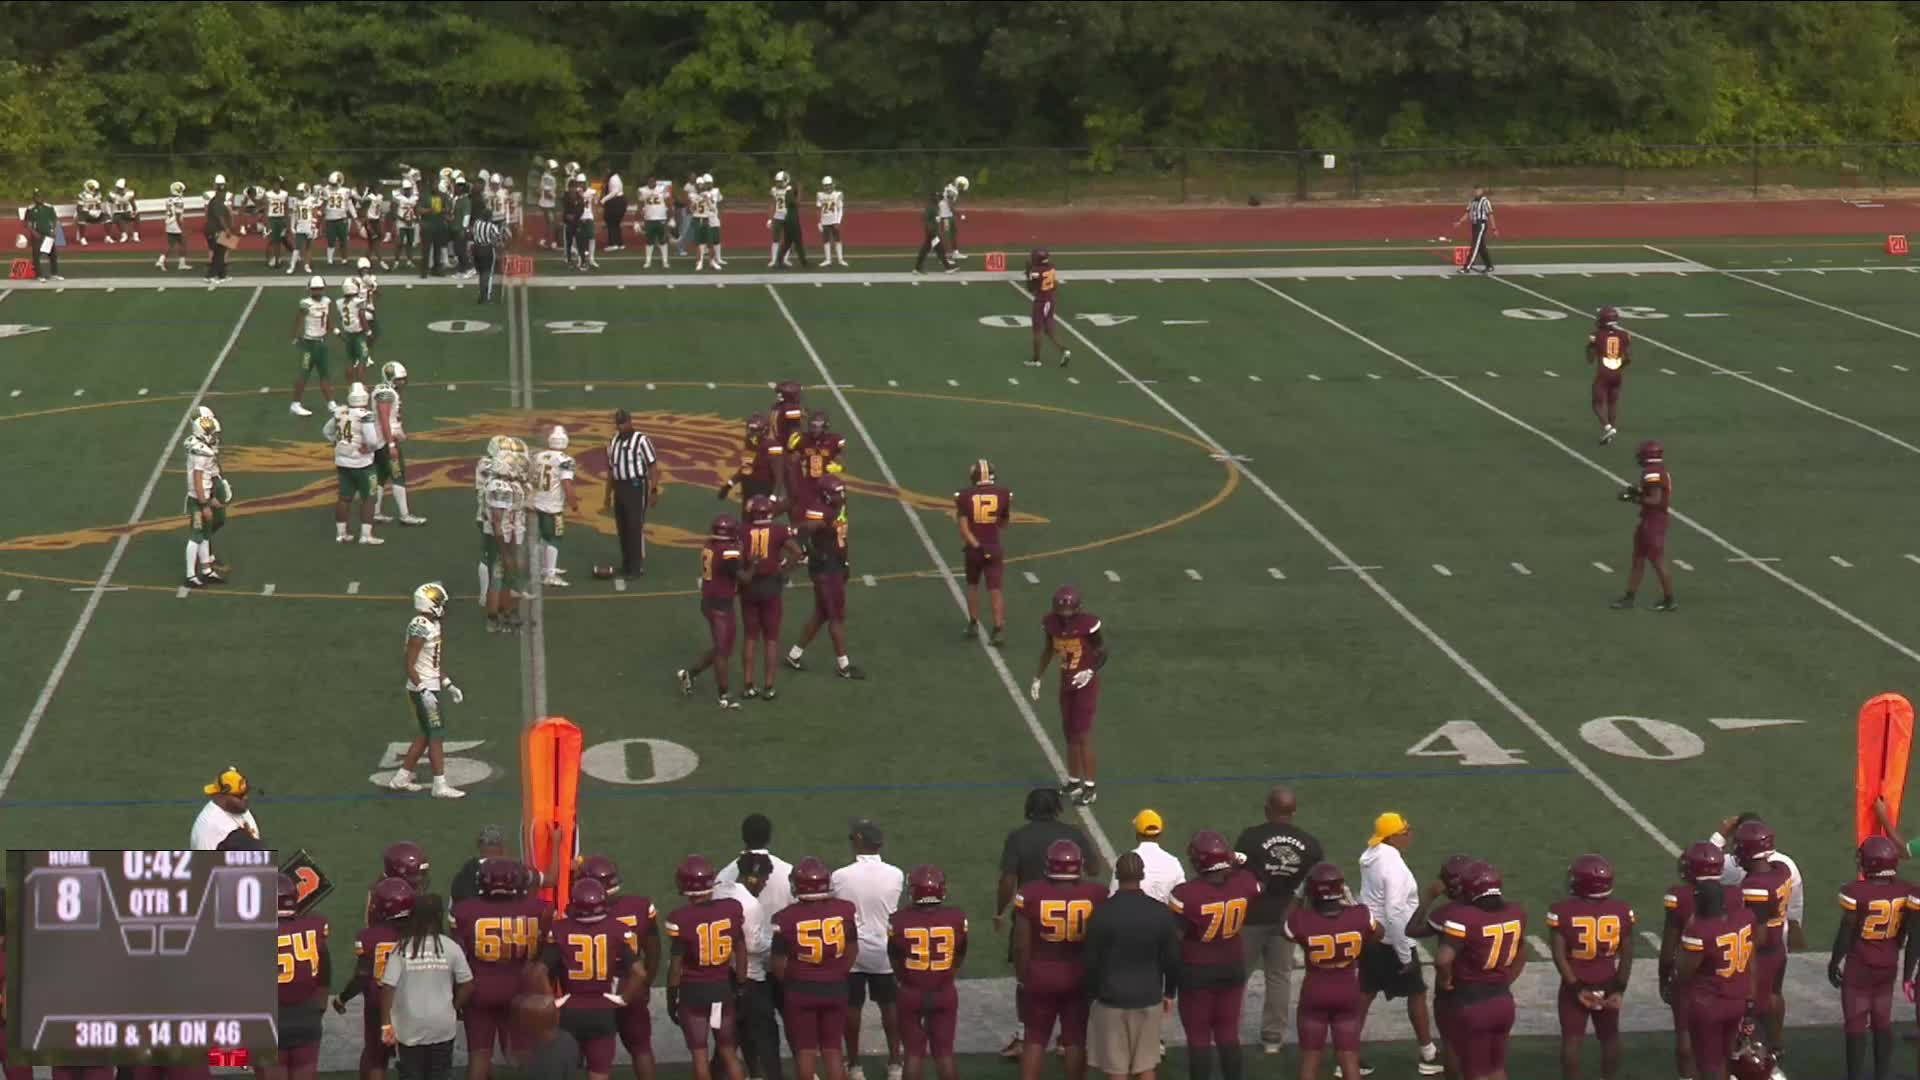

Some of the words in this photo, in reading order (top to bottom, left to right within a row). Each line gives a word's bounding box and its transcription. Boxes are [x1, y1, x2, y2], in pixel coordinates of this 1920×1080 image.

[971, 494, 999, 524] 12
[695, 919, 733, 966] 16
[796, 916, 846, 964] 59
[1040, 899, 1092, 943] 50
[1200, 897, 1248, 943] 70
[1570, 915, 1622, 961] 39
[568, 933, 609, 981] 31
[903, 926, 956, 971] 33
[1308, 931, 1363, 969] 23
[1482, 919, 1522, 970] 77
